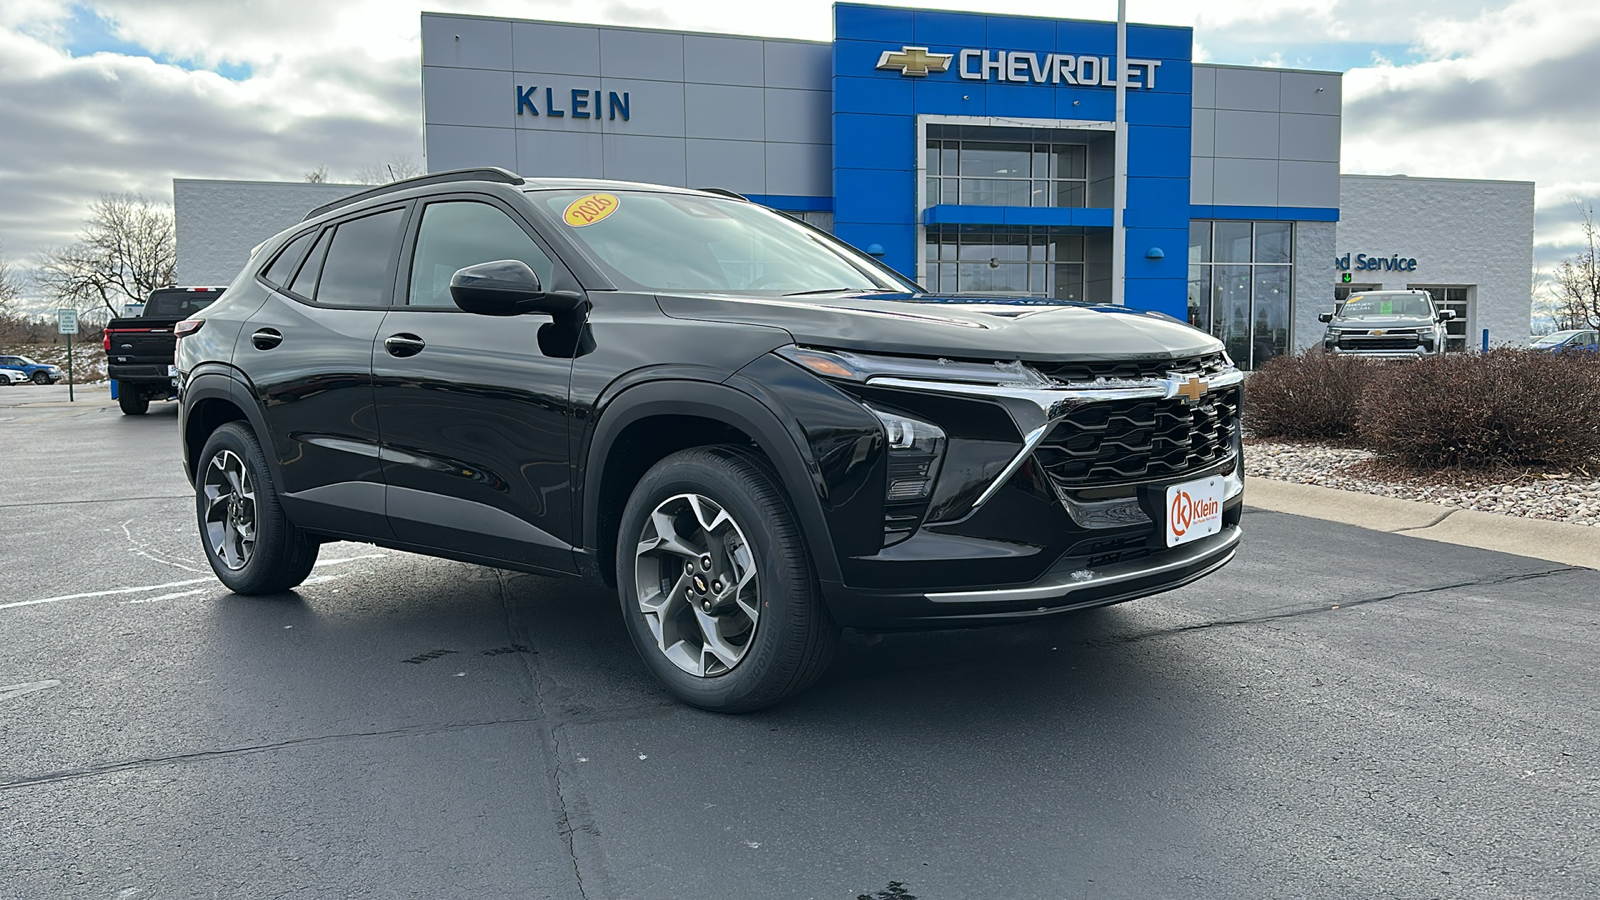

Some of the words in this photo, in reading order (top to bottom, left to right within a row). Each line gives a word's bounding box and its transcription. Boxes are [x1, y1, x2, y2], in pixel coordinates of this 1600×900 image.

[960, 49, 1162, 89] CHEVROLET
[517, 86, 630, 121] KLEIN
[572, 195, 612, 223] 2026
[1356, 253, 1418, 271] Service
[1193, 497, 1218, 519] Klein
